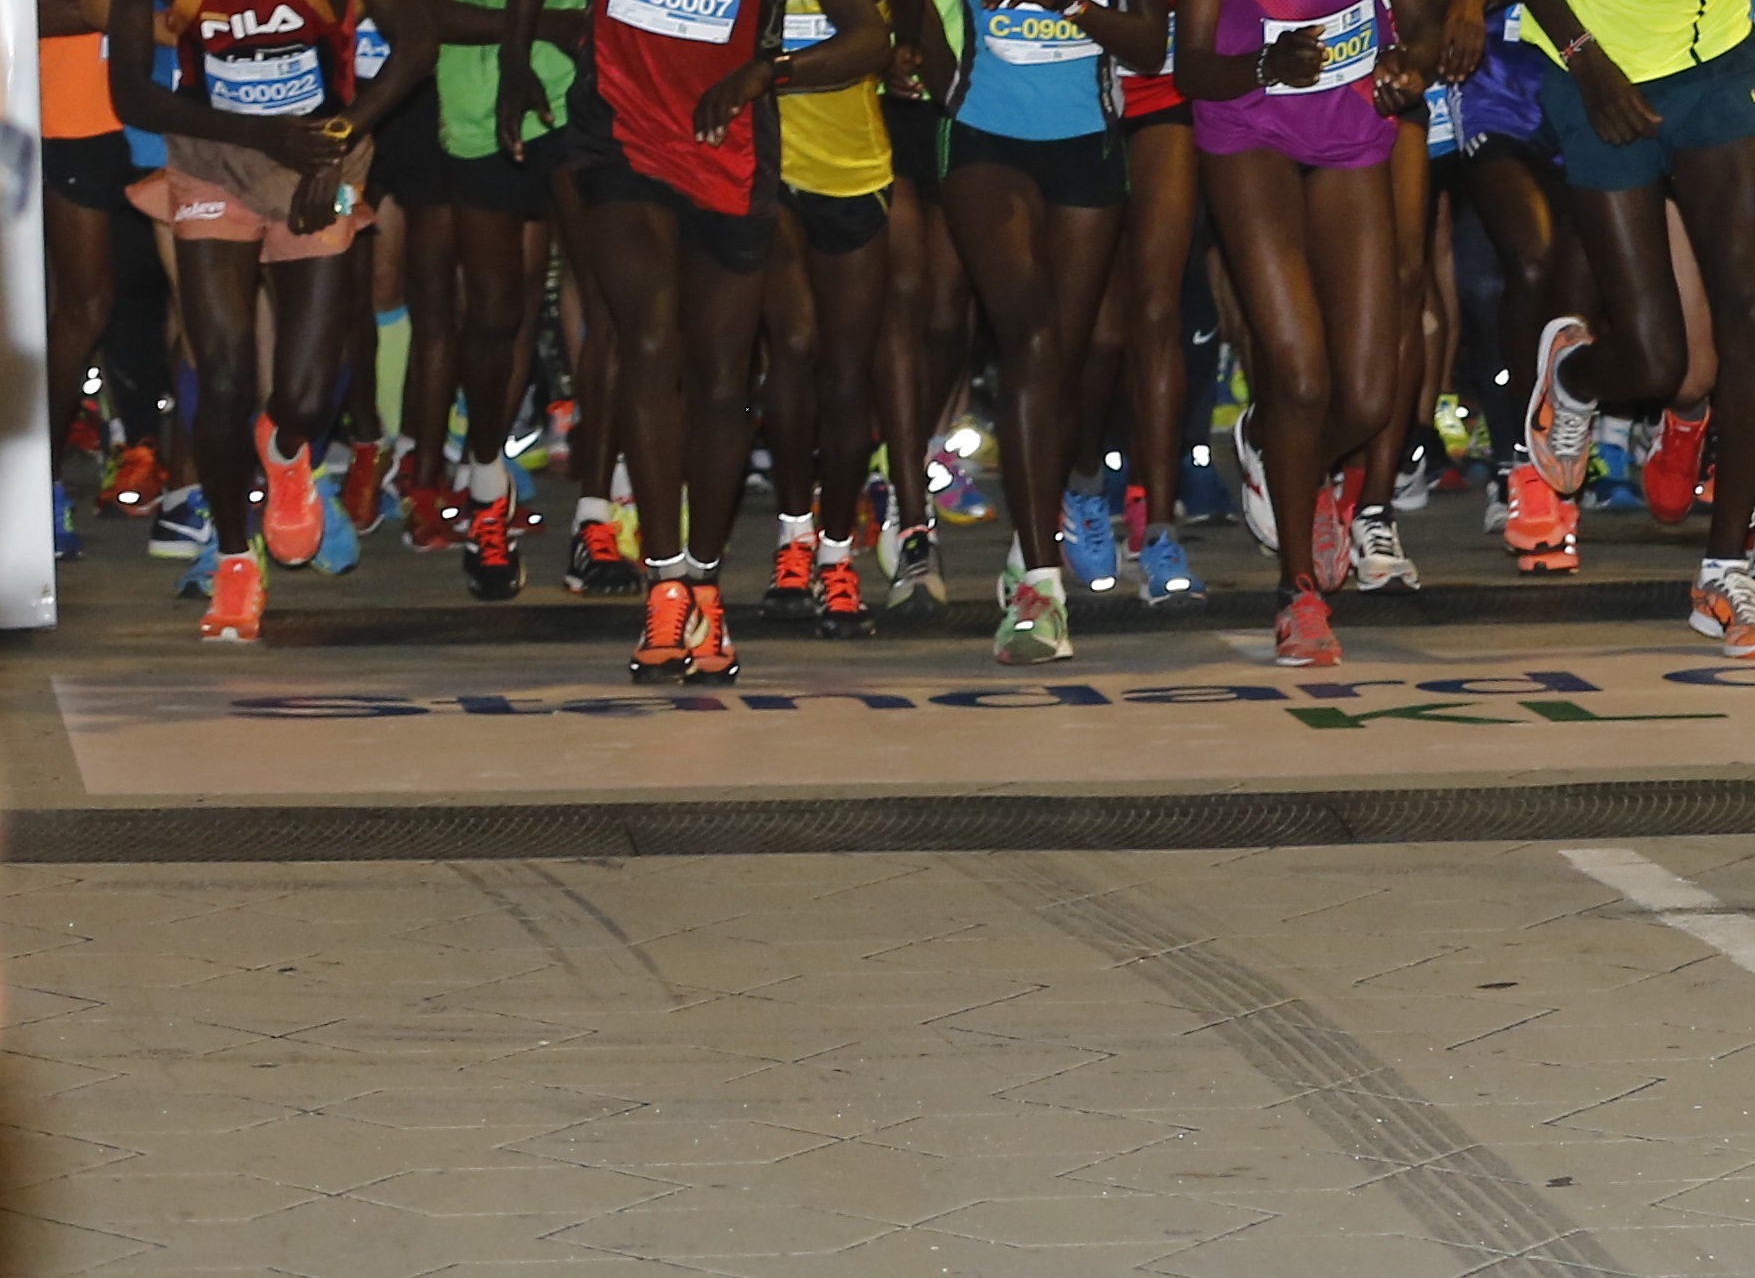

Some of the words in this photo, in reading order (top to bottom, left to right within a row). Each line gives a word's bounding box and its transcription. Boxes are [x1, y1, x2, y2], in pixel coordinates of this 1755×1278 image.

[201, 3, 305, 40] FILA
[212, 74, 317, 103] A-00022
[228, 670, 1603, 718] Standard
[1283, 698, 1728, 731] KL
